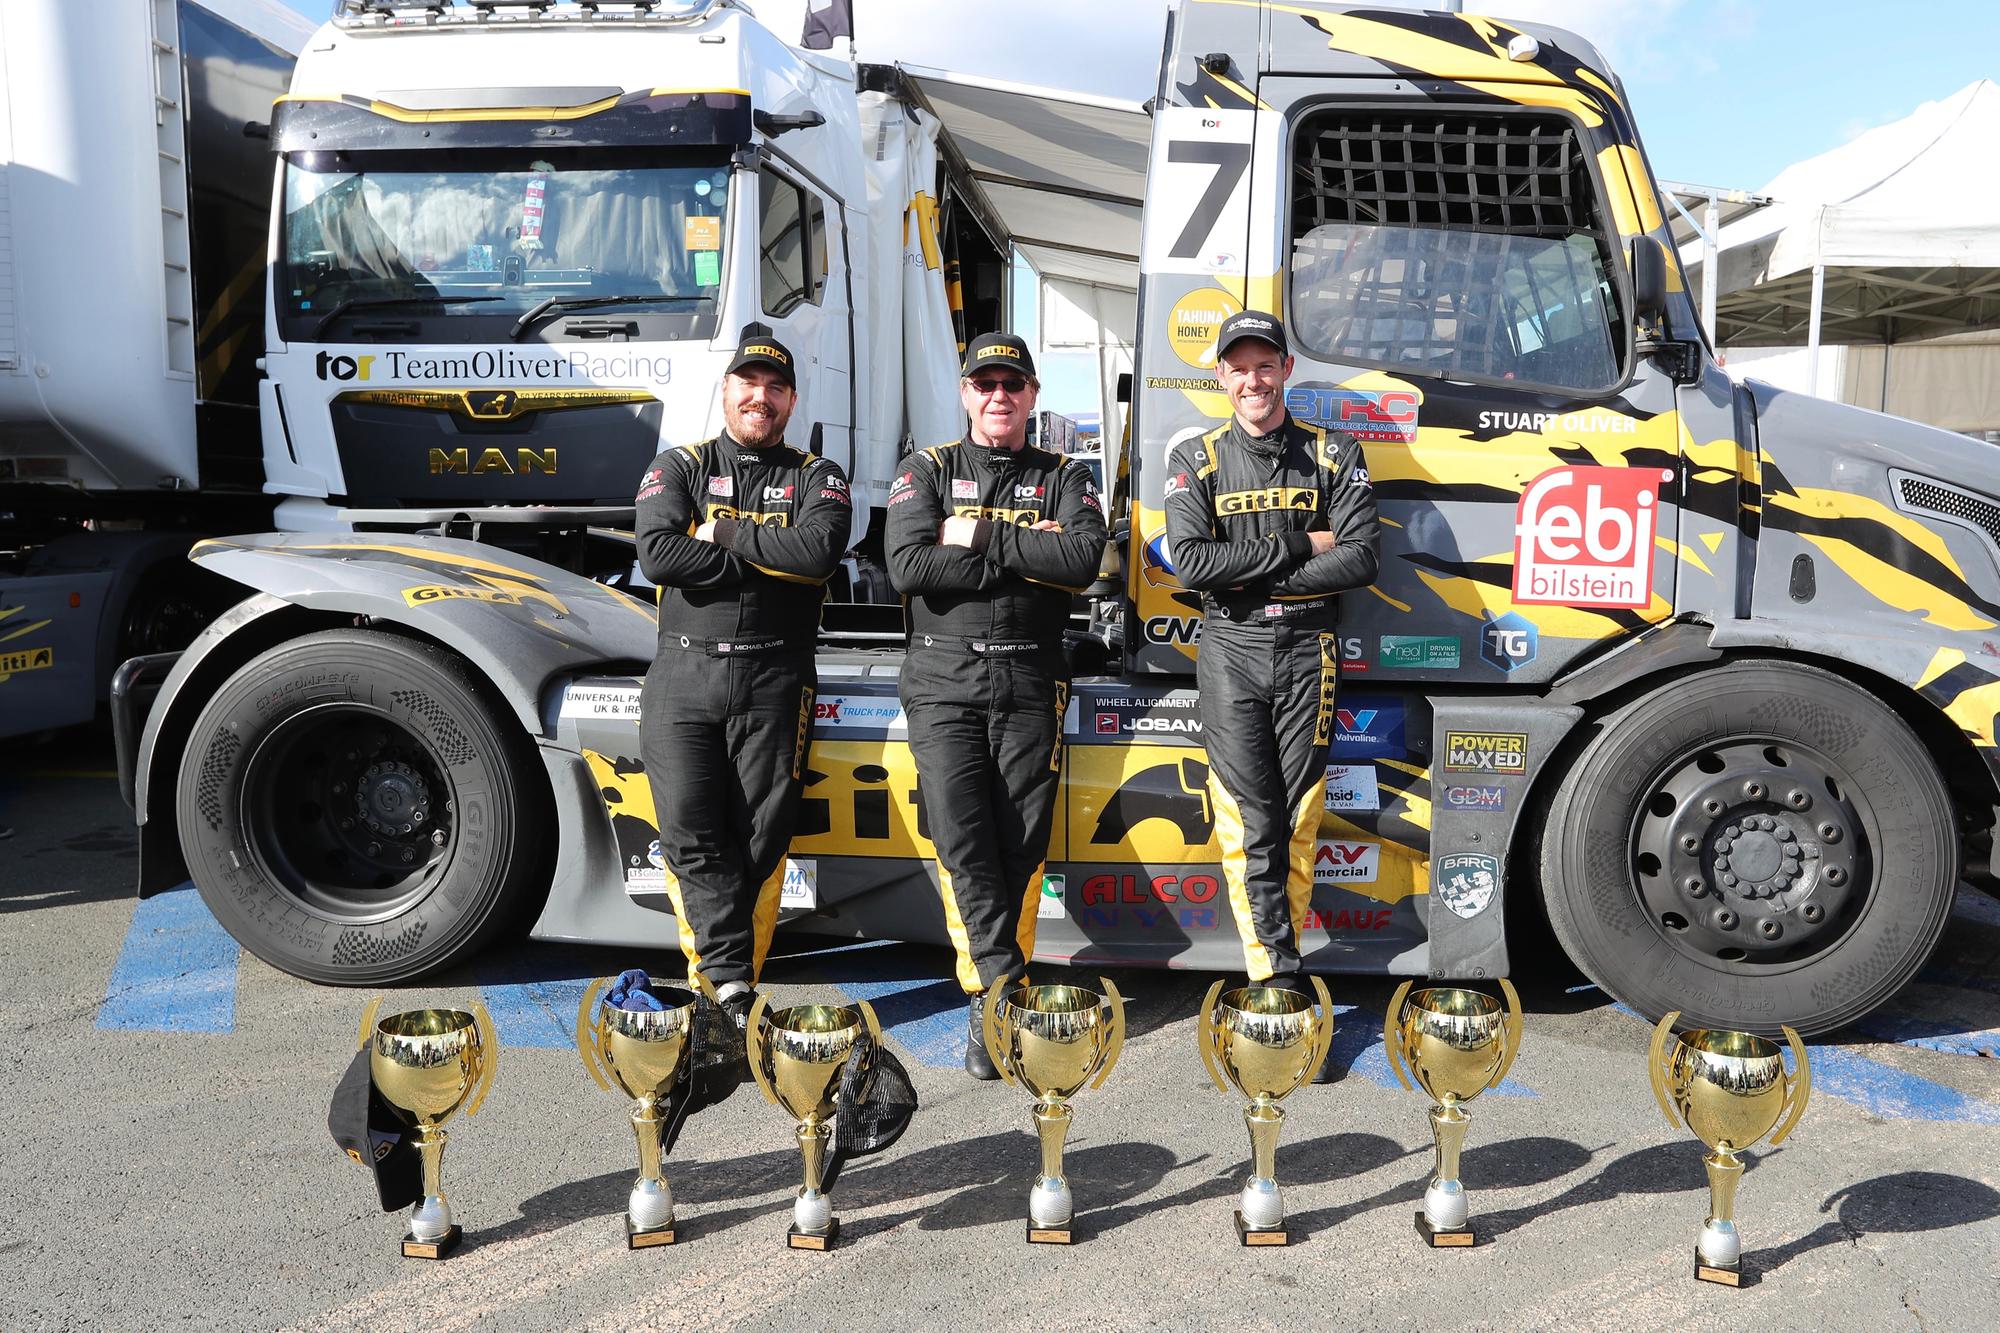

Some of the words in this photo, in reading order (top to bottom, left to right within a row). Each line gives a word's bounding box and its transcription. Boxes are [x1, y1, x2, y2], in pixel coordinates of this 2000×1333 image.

[1167, 140, 1252, 259] 7
[1177, 309, 1224, 323] TAHUNA
[1177, 326, 1209, 338] HONEY
[532, 393, 559, 401] YEARS
[577, 393, 633, 401] TRANSPORT
[1327, 422, 1367, 430] TRUCK
[1369, 422, 1415, 433] RACING
[1478, 411, 1559, 431] STUART
[1562, 413, 1637, 433] OLIVER
[429, 448, 558, 475] MAN
[1220, 491, 1280, 512] Giti
[1515, 471, 1654, 563] febi
[1530, 568, 1634, 599] bilstein
[412, 583, 483, 602] Giti
[734, 643, 764, 651] MICHAEL
[1486, 630, 1528, 657] TG
[1, 652, 28, 669] iti
[566, 693, 626, 702] UNIVERSAL
[1096, 698, 1133, 707] WHEEL
[1134, 699, 1196, 708] ALIGNMENT
[594, 704, 607, 713] UK
[612, 704, 619, 713] &
[814, 702, 840, 719] ex
[843, 707, 877, 717] TRUCK
[1319, 675, 1335, 740] Giti
[1335, 732, 1377, 743] Valvoline
[1450, 736, 1521, 752] POWER
[1449, 750, 1521, 769] MAXED
[1325, 789, 1362, 801] hside
[1448, 786, 1502, 806] GDM
[1444, 858, 1492, 870] BARC
[1081, 874, 1220, 907] ALCO
